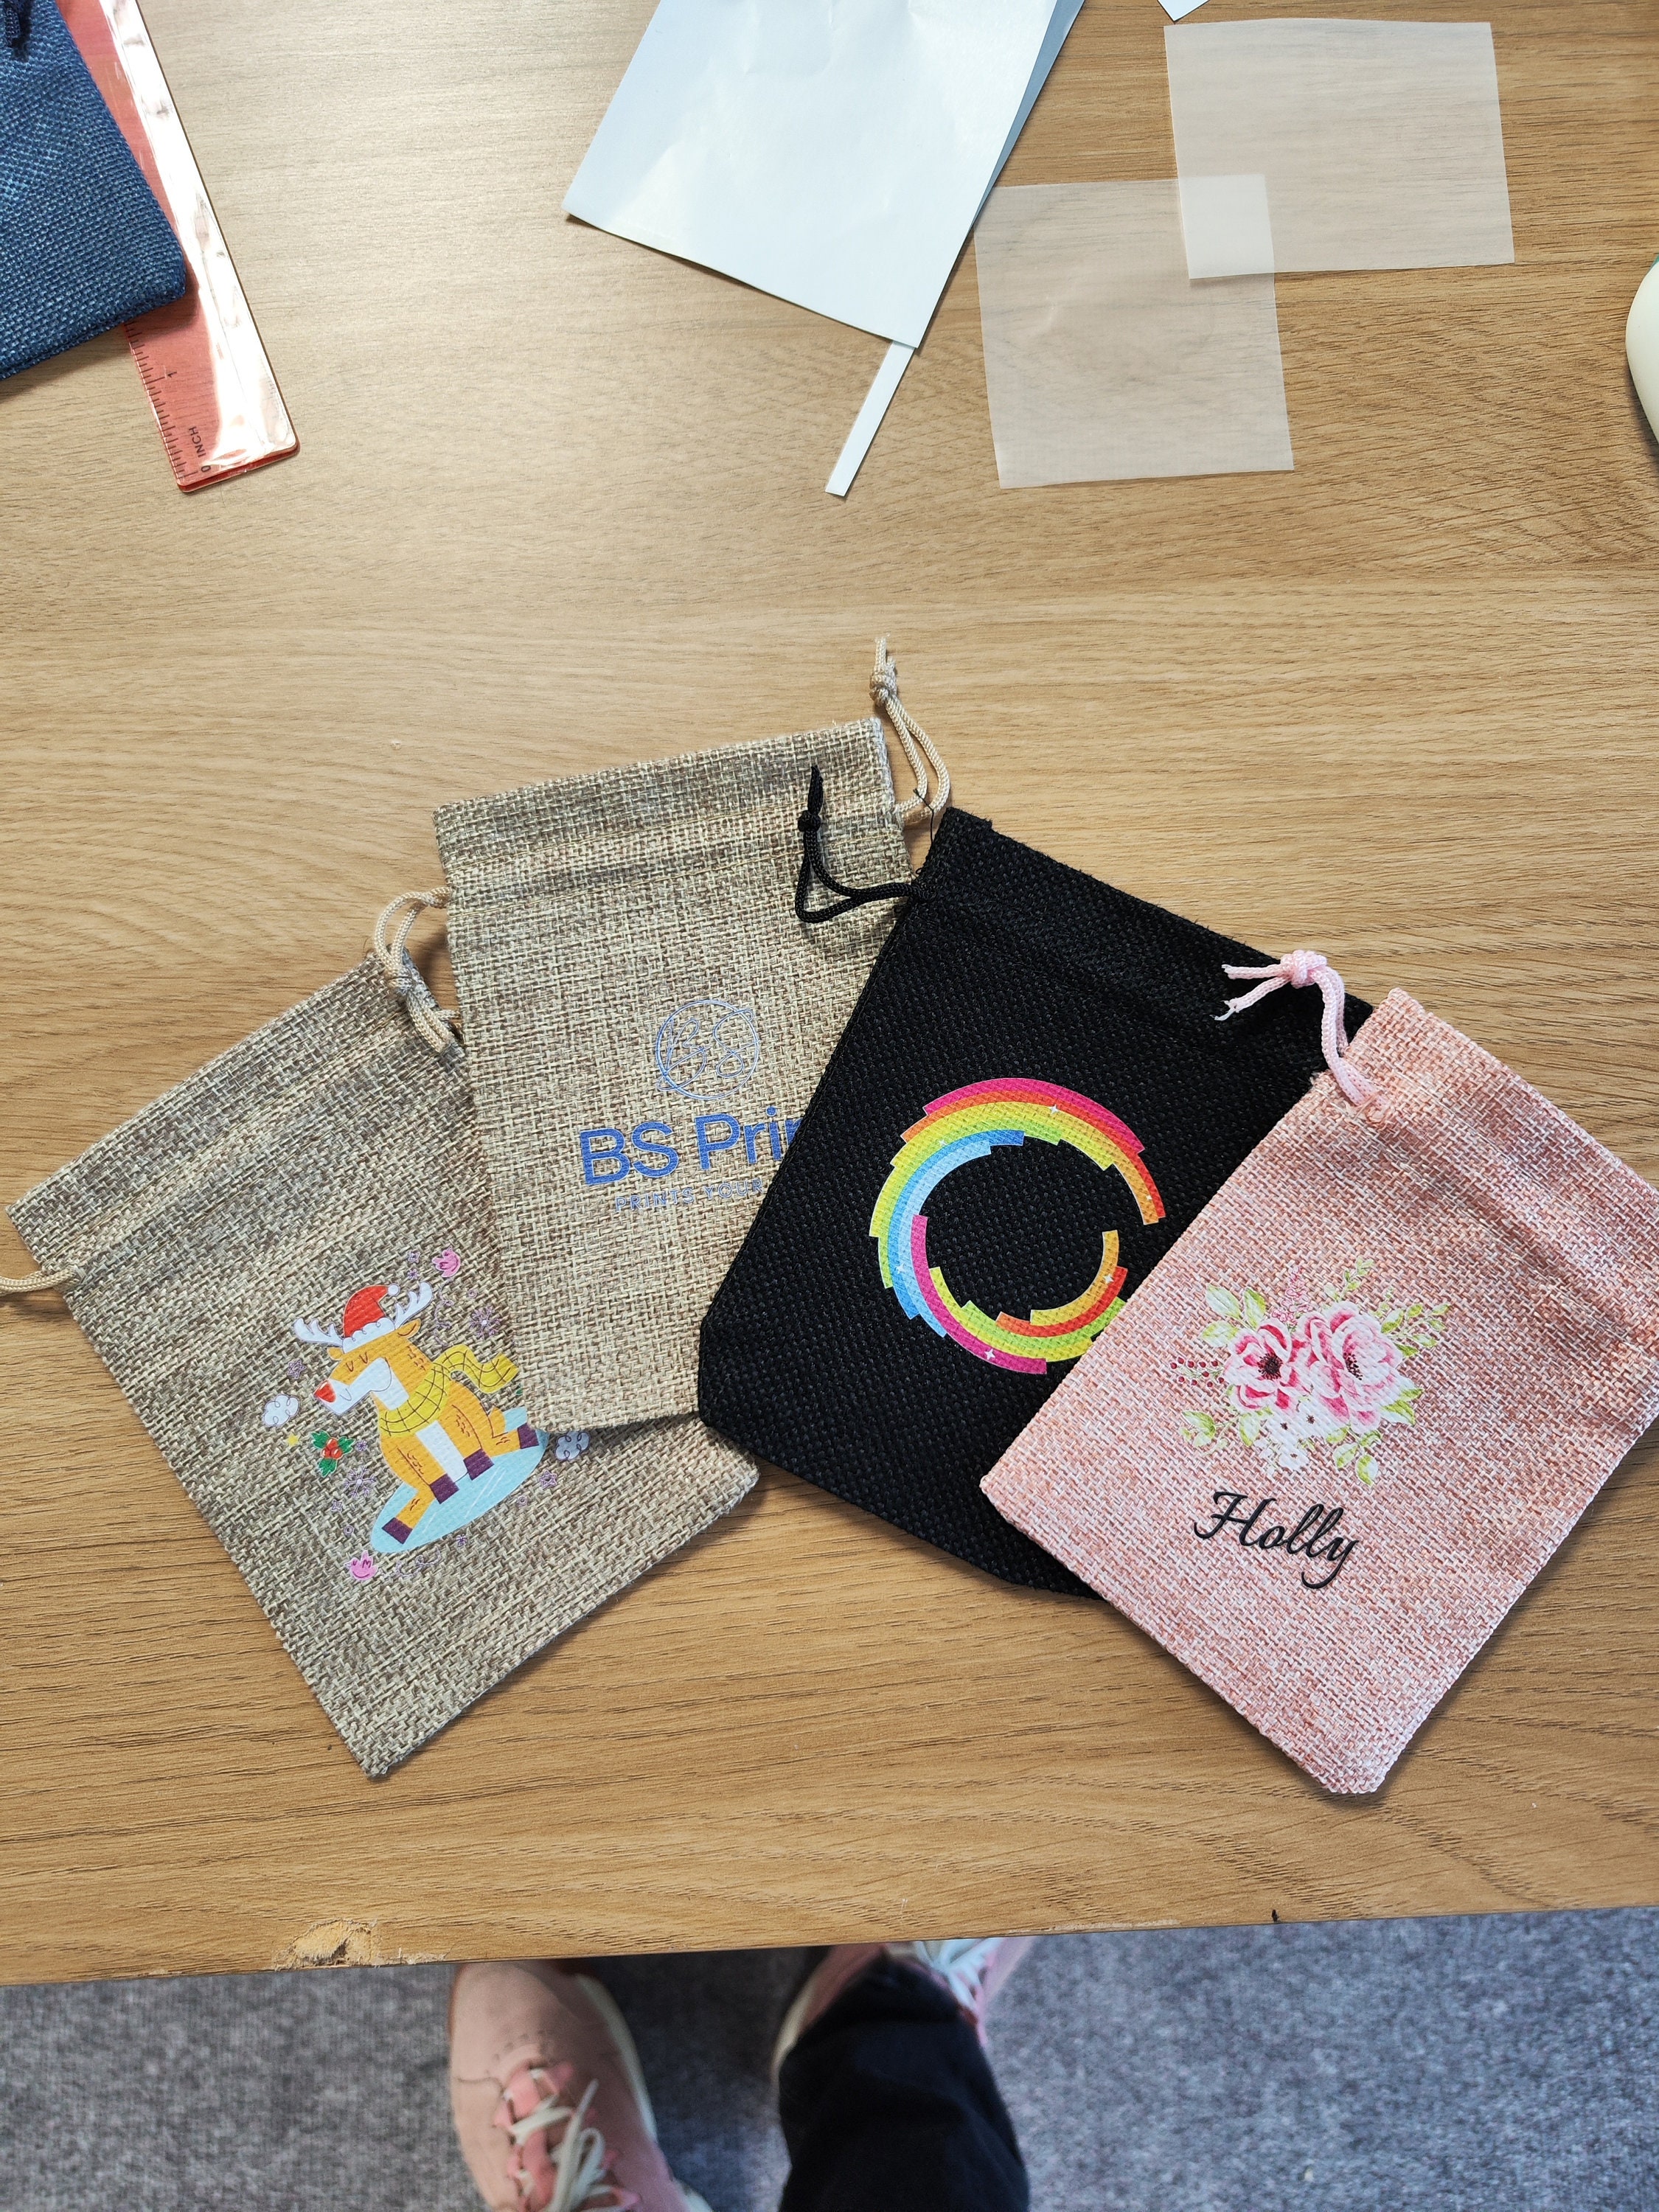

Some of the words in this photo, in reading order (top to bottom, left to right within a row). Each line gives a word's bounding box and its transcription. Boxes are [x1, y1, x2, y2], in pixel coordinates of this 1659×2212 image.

[189, 426, 206, 458] INCH
[580, 1121, 679, 1186] BS
[615, 1187, 695, 1212] PRINTS
[703, 1178, 764, 1200] YOUR
[1193, 1491, 1360, 1589] Holly
